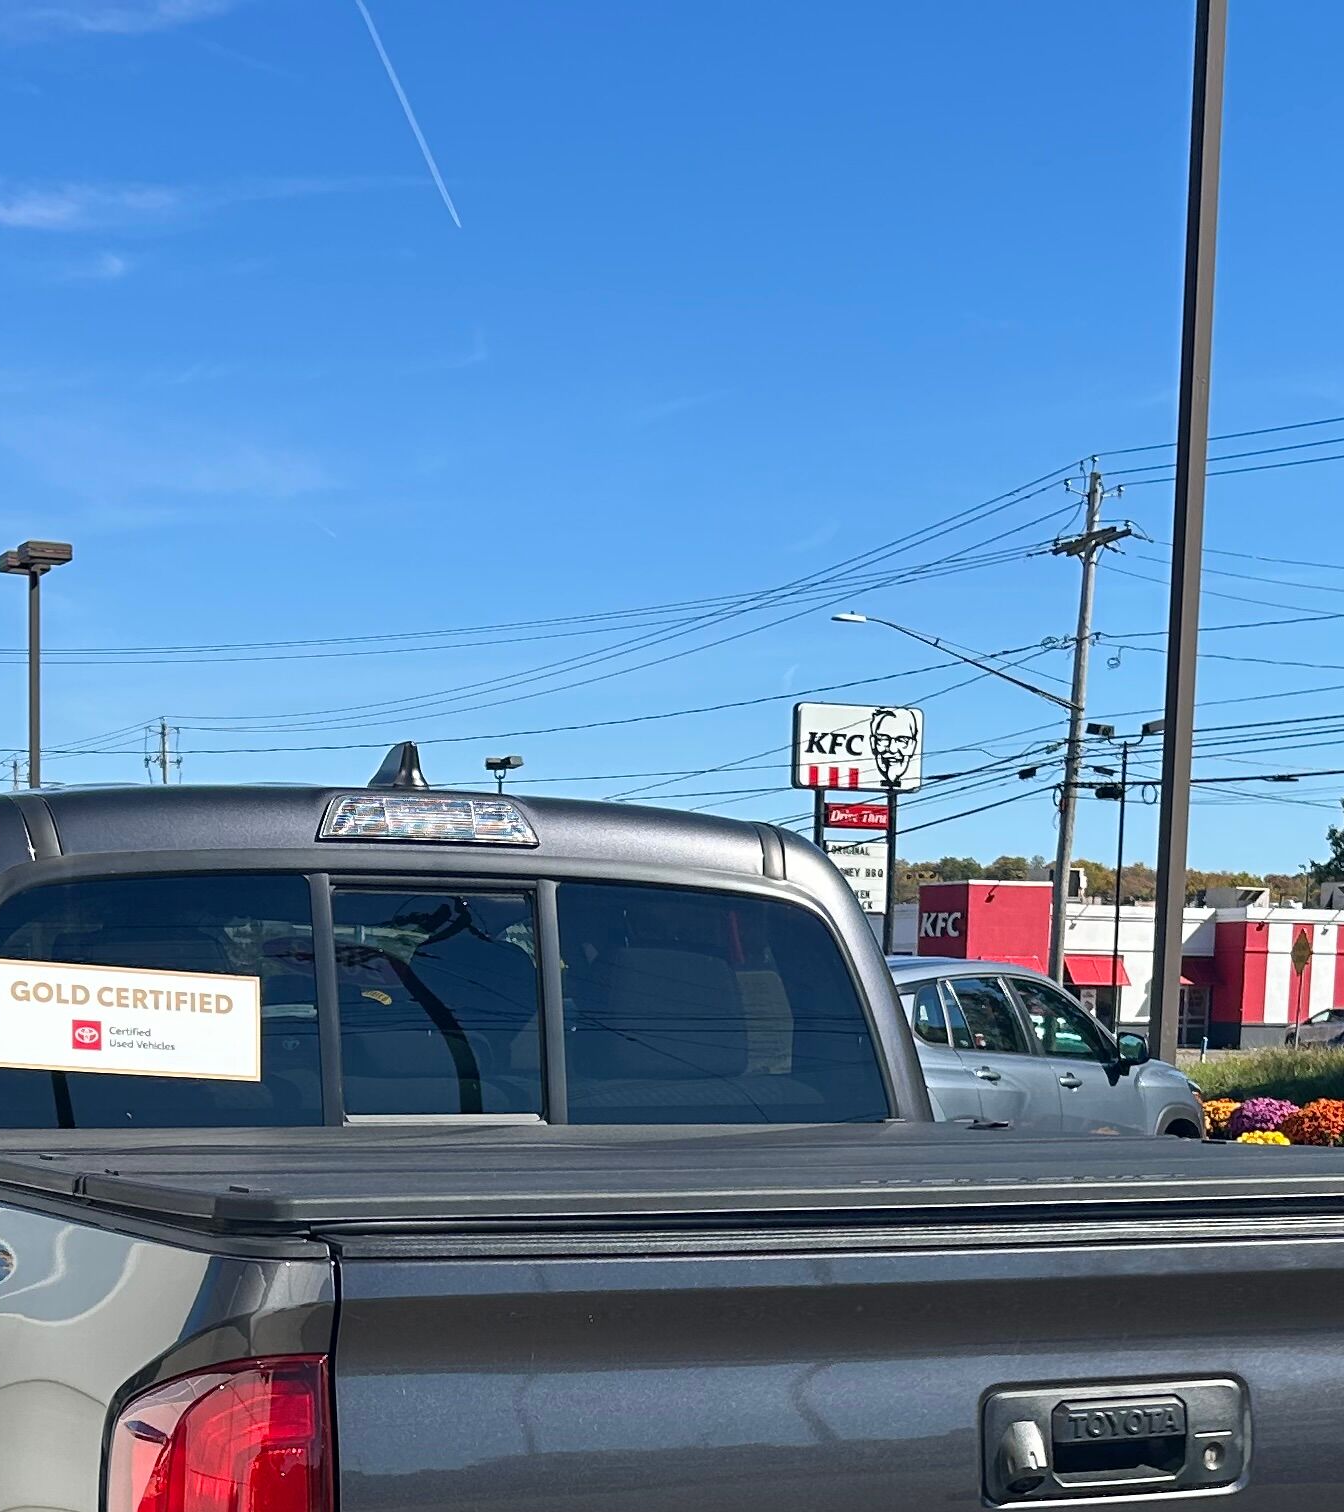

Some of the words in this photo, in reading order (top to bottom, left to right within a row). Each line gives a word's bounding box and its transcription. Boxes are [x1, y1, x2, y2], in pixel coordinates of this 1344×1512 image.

[805, 731, 864, 756] KFC
[860, 810, 887, 824] Thru
[831, 844, 871, 856] ORIGINAL
[865, 868, 884, 878] BBQ
[920, 911, 962, 938] KFC
[10, 980, 91, 1005] GOLD
[97, 986, 234, 1014] CERTIFIED
[109, 1026, 152, 1037] Certified
[109, 1039, 134, 1050] Used
[136, 1040, 176, 1051] Vehicles
[1068, 1406, 1180, 1439] TOYOTA
